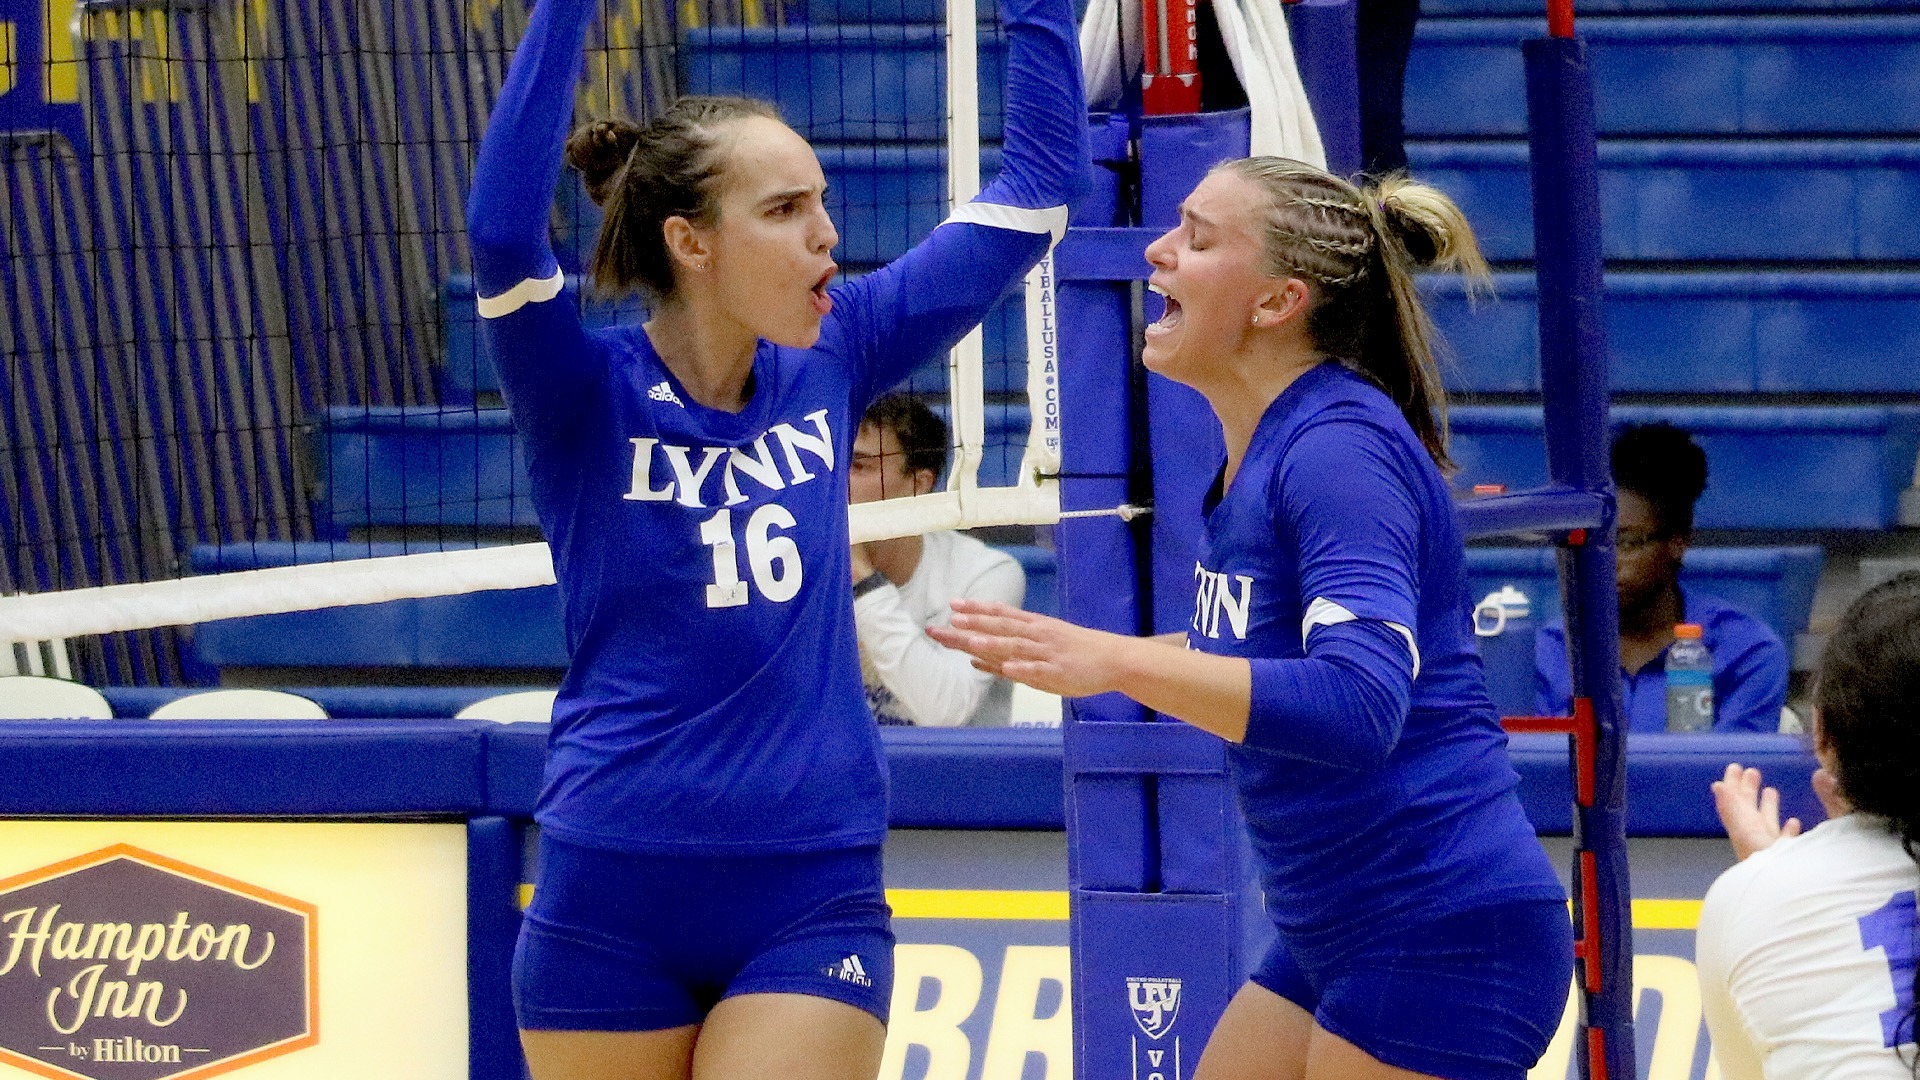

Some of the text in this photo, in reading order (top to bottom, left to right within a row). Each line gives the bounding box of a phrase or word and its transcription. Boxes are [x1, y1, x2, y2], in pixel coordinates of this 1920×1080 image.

[623, 409, 835, 508] LYNN
[700, 503, 803, 608] 16
[0, 904, 275, 977] Hampton
[47, 964, 188, 1035] Inn
[69, 1036, 183, 1064] by Hilton
